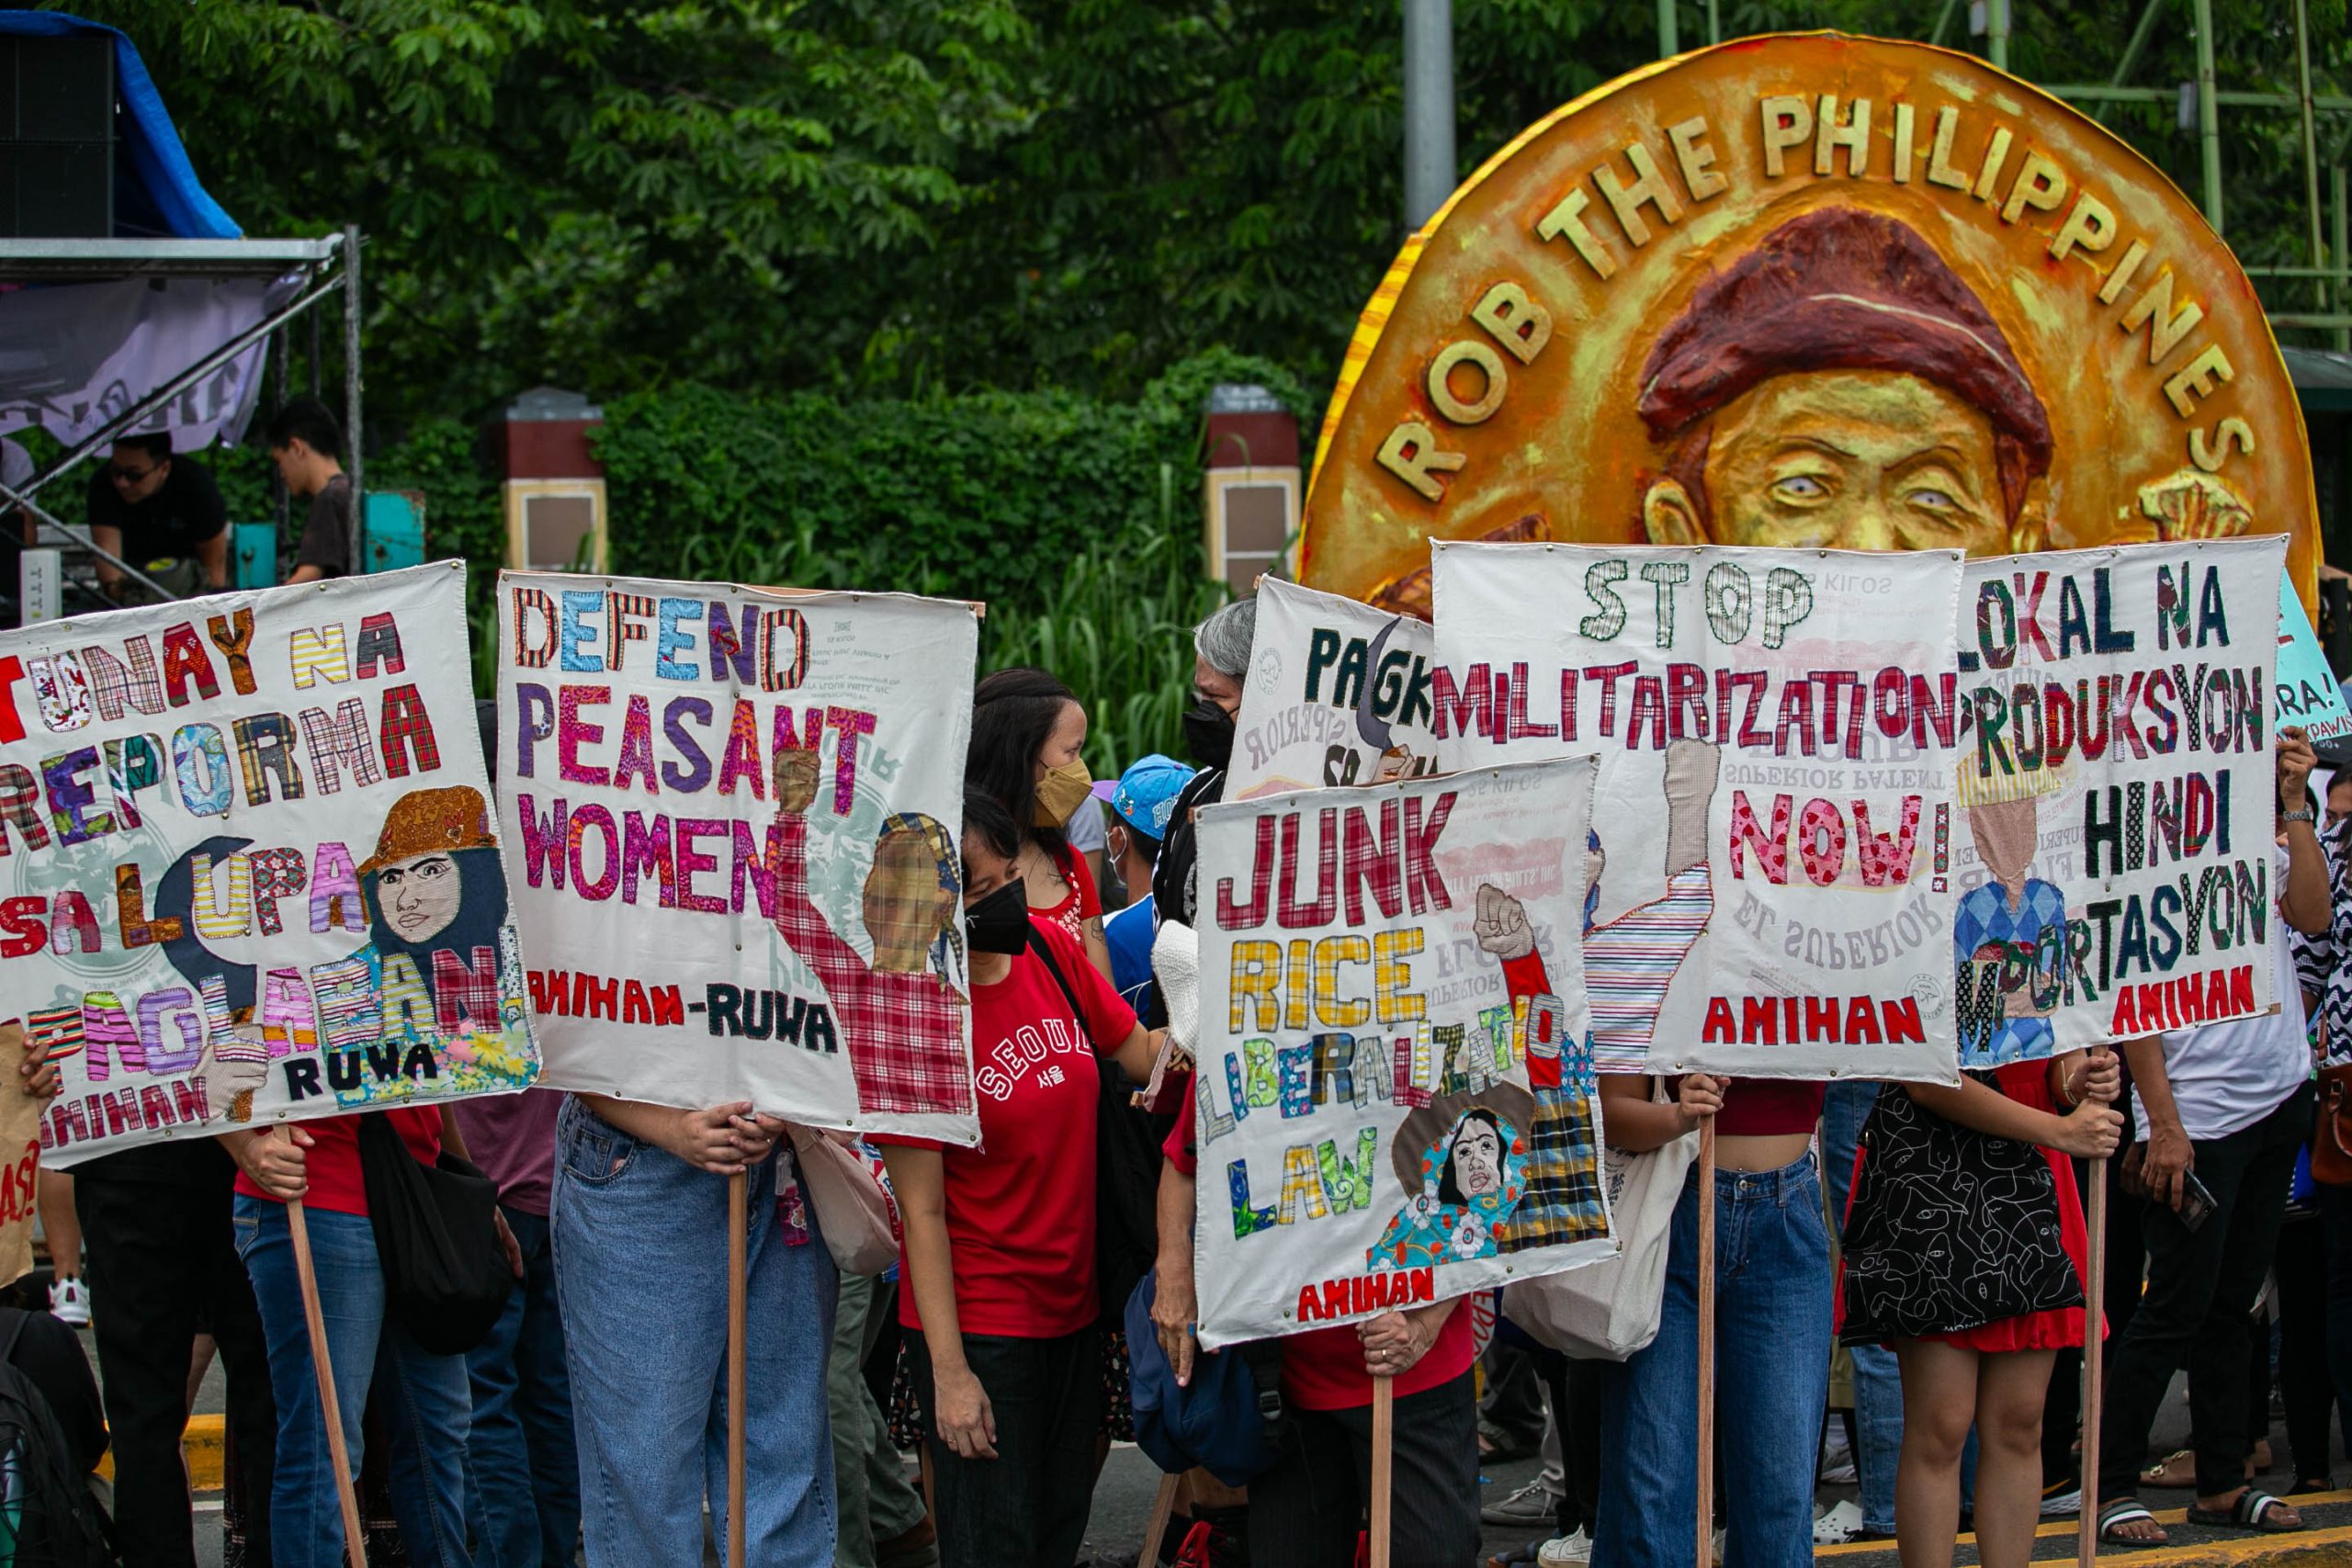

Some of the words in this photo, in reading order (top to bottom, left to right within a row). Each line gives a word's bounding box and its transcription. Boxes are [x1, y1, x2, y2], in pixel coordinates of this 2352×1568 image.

[1374, 280, 1555, 502] ROB
[1535, 115, 1731, 280] THE
[1758, 94, 2256, 473] PHILIPPINES
[512, 587, 811, 694] DEFEND
[1579, 558, 1814, 649] STOP
[1958, 568, 2135, 672] OKAL
[2156, 560, 2231, 651] NA
[0, 607, 258, 745] TUNAY
[290, 611, 405, 691] NA
[1305, 627, 1436, 735] PAGK
[1431, 660, 1959, 760] MILITARIZATION
[2276, 672, 2335, 722] RA!
[0, 682, 442, 856] REPORMA
[516, 682, 877, 817] PEASANT
[517, 794, 780, 919] WOMEN
[1216, 792, 1459, 931] JUNK
[1729, 790, 1950, 893] NOW!
[2085, 769, 2231, 879] HINDI
[1228, 926, 1427, 1034] RICE
[1955, 858, 2266, 1054] MPORTASYON
[2113, 964, 2256, 1036] AMIHAN
[28, 945, 503, 1096] PAGLABAN
[284, 1043, 439, 1101] RUWA
[976, 1018, 1094, 1101] SEOUL
[1196, 993, 1597, 1146] LIBERALIZATION
[1702, 995, 1927, 1045] AMIHAN
[1036, 1065, 1066, 1089] 서울
[1227, 1126, 1377, 1241] LAW
[1297, 1268, 1434, 1323] AMIHAN
